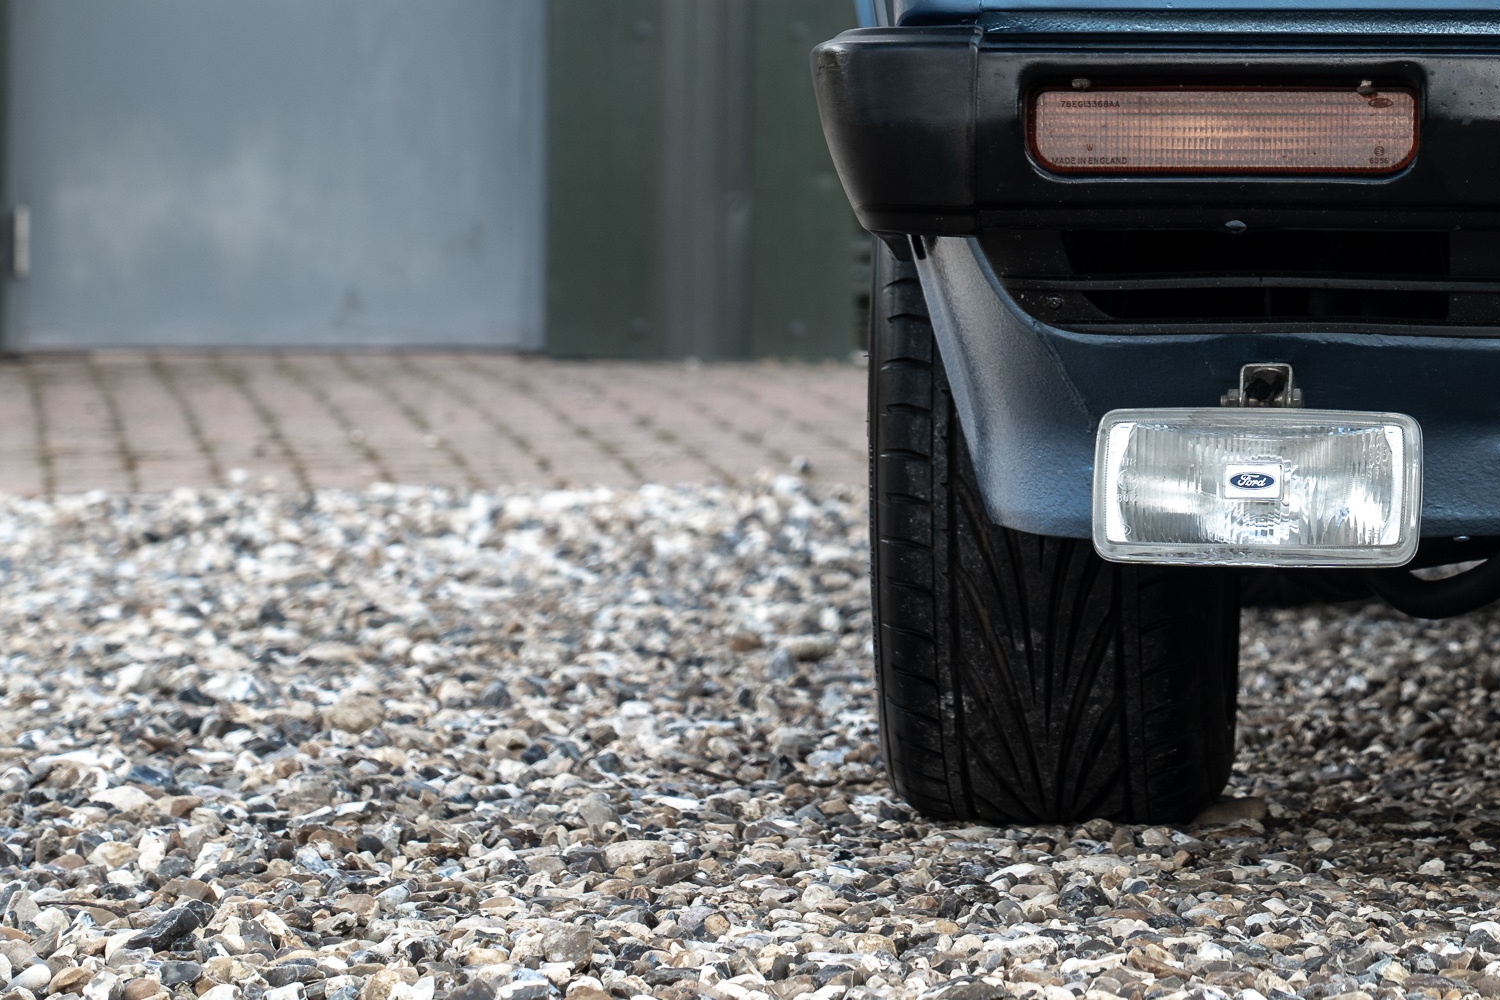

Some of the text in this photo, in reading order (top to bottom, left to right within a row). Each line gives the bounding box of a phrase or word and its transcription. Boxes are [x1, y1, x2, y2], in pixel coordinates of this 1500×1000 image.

[1051, 157, 1128, 165] MADE IN ENGLAND
[1237, 474, 1267, 487] Ford
